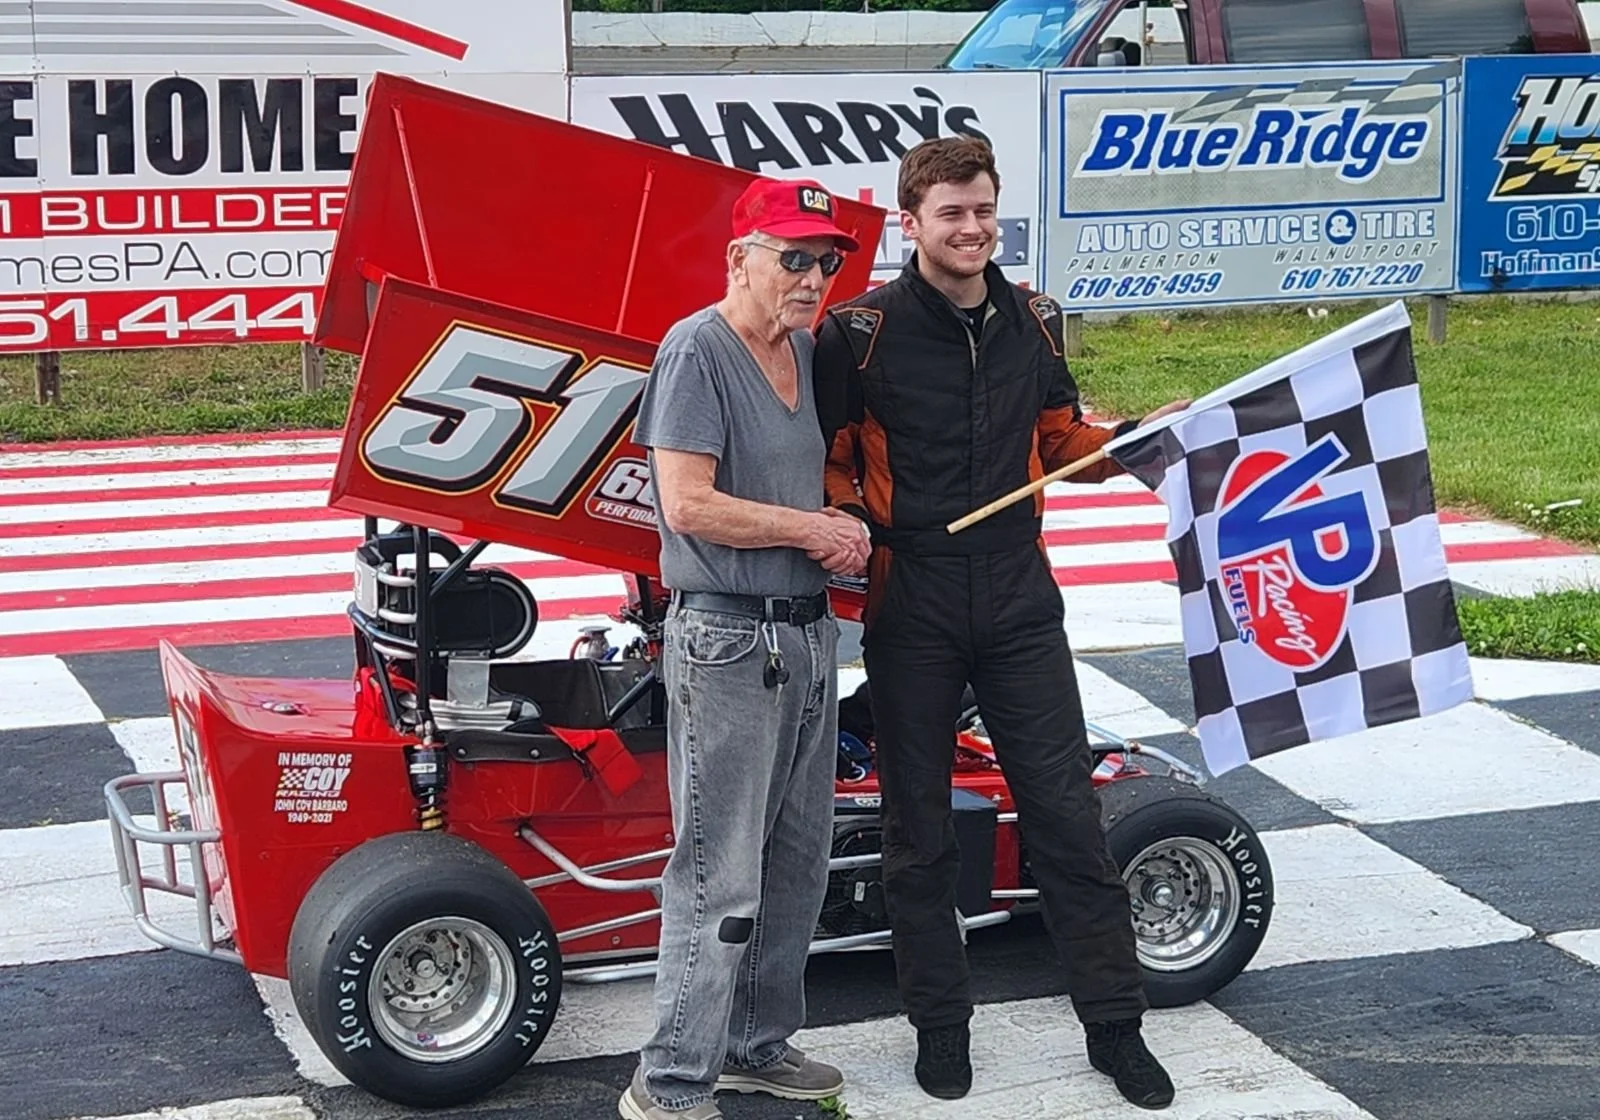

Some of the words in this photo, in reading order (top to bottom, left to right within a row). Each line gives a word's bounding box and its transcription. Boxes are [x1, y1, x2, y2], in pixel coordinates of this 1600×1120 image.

[68, 76, 372, 176] HOME
[1081, 111, 1239, 172] Blue
[1237, 106, 1428, 179] Ridge
[803, 189, 829, 211] CAT
[1077, 221, 1170, 253] AUTO
[1179, 213, 1320, 249] SERVICE
[1361, 209, 1435, 241] TIRE
[1066, 252, 1220, 272] PALMERTON
[1274, 242, 1439, 263] WALNUTPORT
[359, 319, 651, 520] 51
[1216, 436, 1378, 588] VP
[1223, 566, 1256, 644] FUELS
[1242, 554, 1322, 664] Racing
[278, 752, 291, 766] IN
[291, 752, 336, 766] MEMORY
[337, 753, 352, 767] OF
[303, 767, 351, 791] COY
[1216, 825, 1264, 929] Hoosier
[336, 935, 374, 1053] Hoosier
[513, 930, 550, 1047] Hoosier
